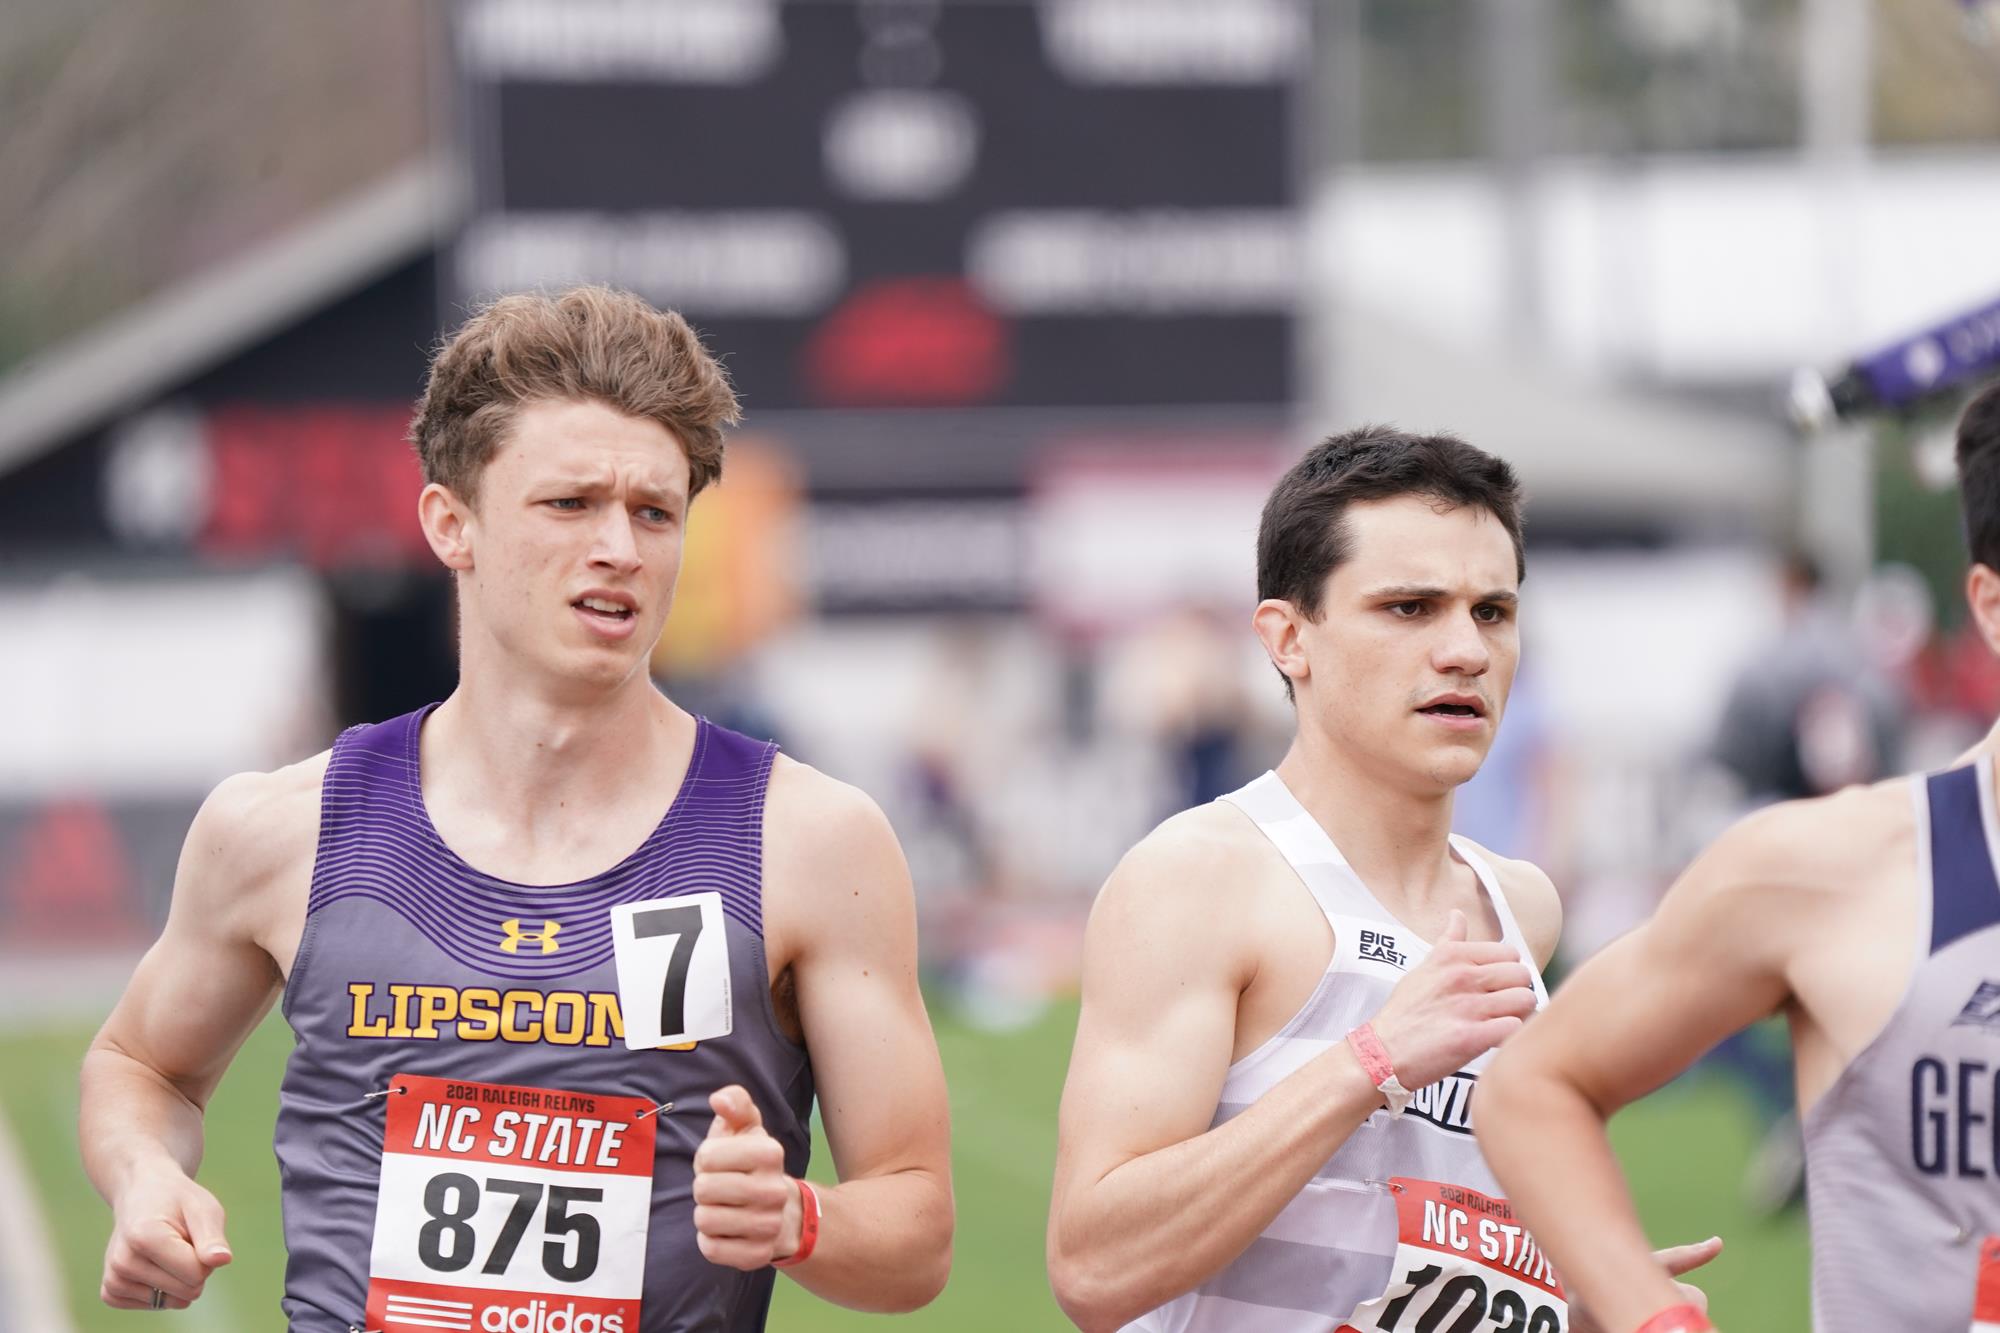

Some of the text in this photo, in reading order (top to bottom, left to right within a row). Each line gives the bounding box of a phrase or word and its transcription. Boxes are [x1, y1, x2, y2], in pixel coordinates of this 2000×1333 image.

[1359, 943, 1407, 966] EAST
[1360, 929, 1395, 950] BIG
[632, 904, 703, 1037] 7
[446, 1084, 596, 1113] 2021 RALEIGH RELAYS
[1911, 1055, 2000, 1180] GE
[412, 1102, 629, 1167] NC STATE
[1440, 1187, 1512, 1219] 2021 RALEIGH
[418, 1172, 604, 1283] 875
[1422, 1199, 1469, 1251] NC
[480, 1300, 625, 1333] adidas
